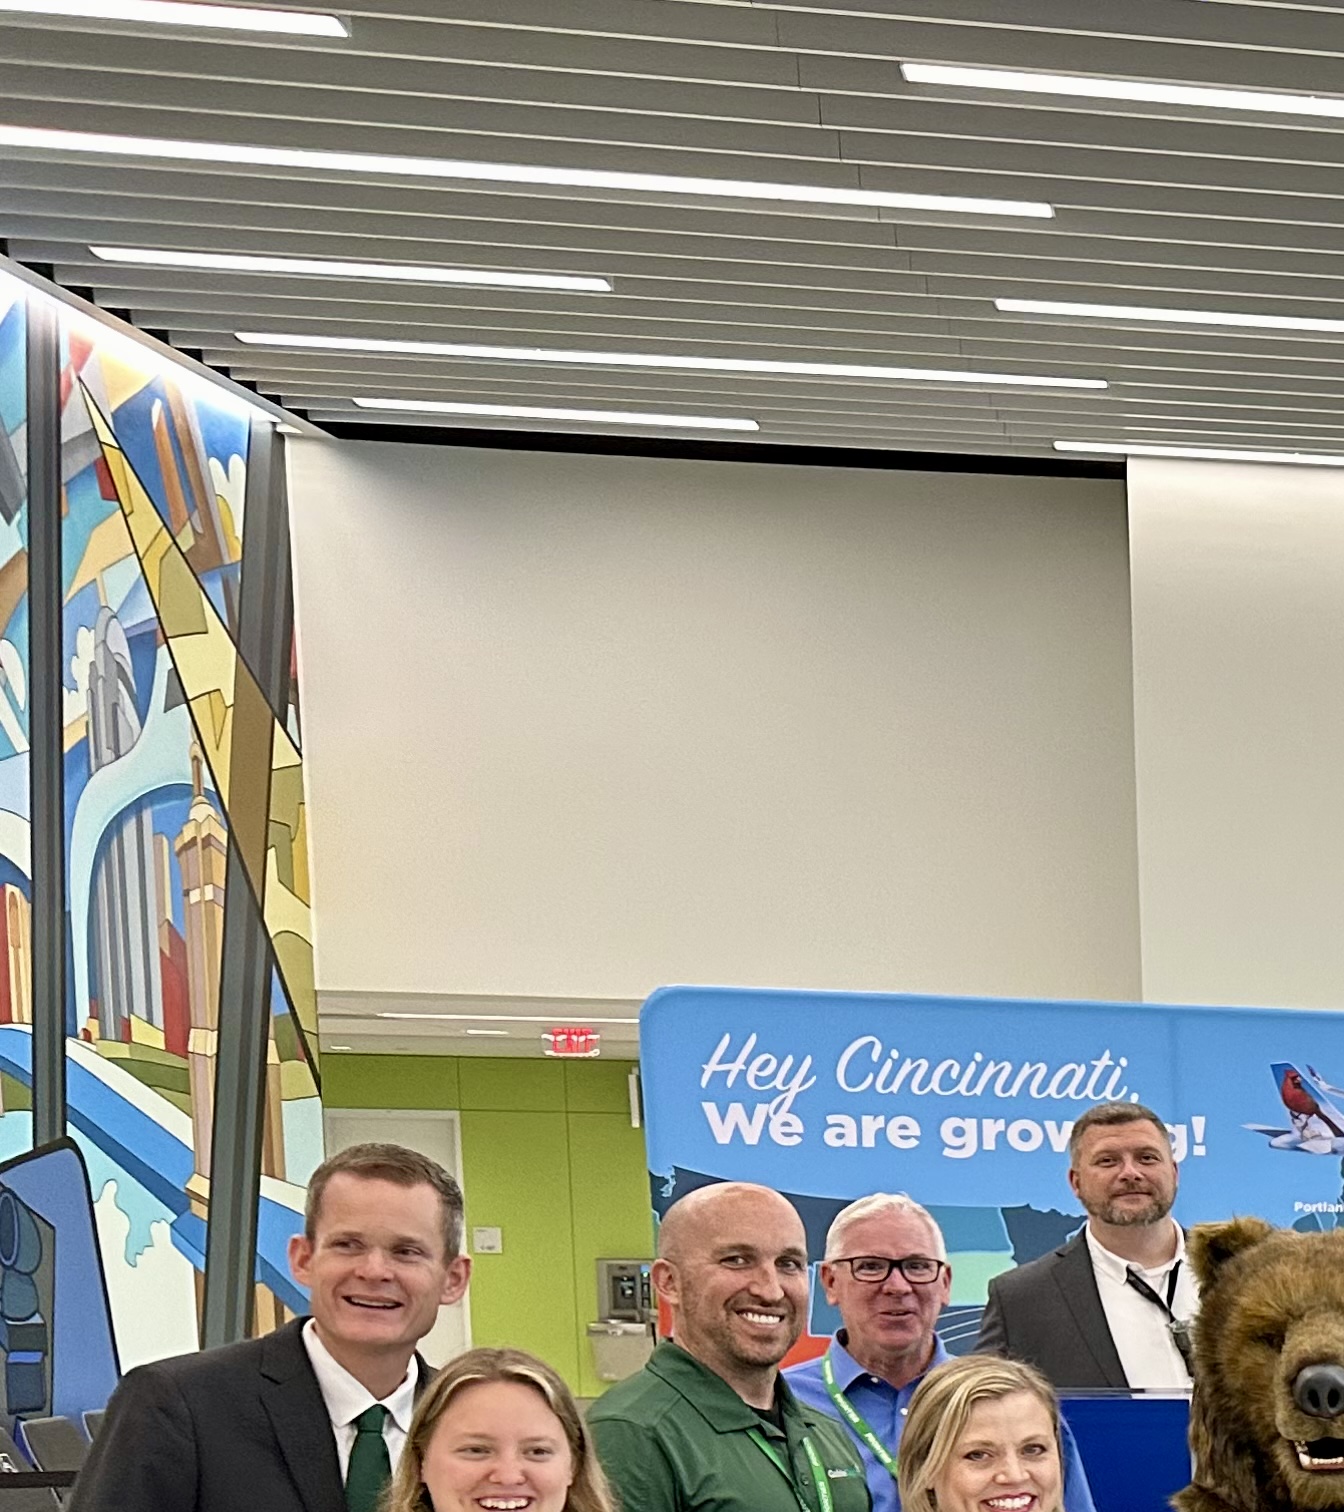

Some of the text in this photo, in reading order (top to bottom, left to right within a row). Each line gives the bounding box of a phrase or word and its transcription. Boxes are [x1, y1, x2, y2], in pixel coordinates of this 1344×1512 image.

[700, 1033, 1140, 1121] Hey Cincinnati,
[701, 1101, 804, 1146] We
[824, 1114, 921, 1149] are
